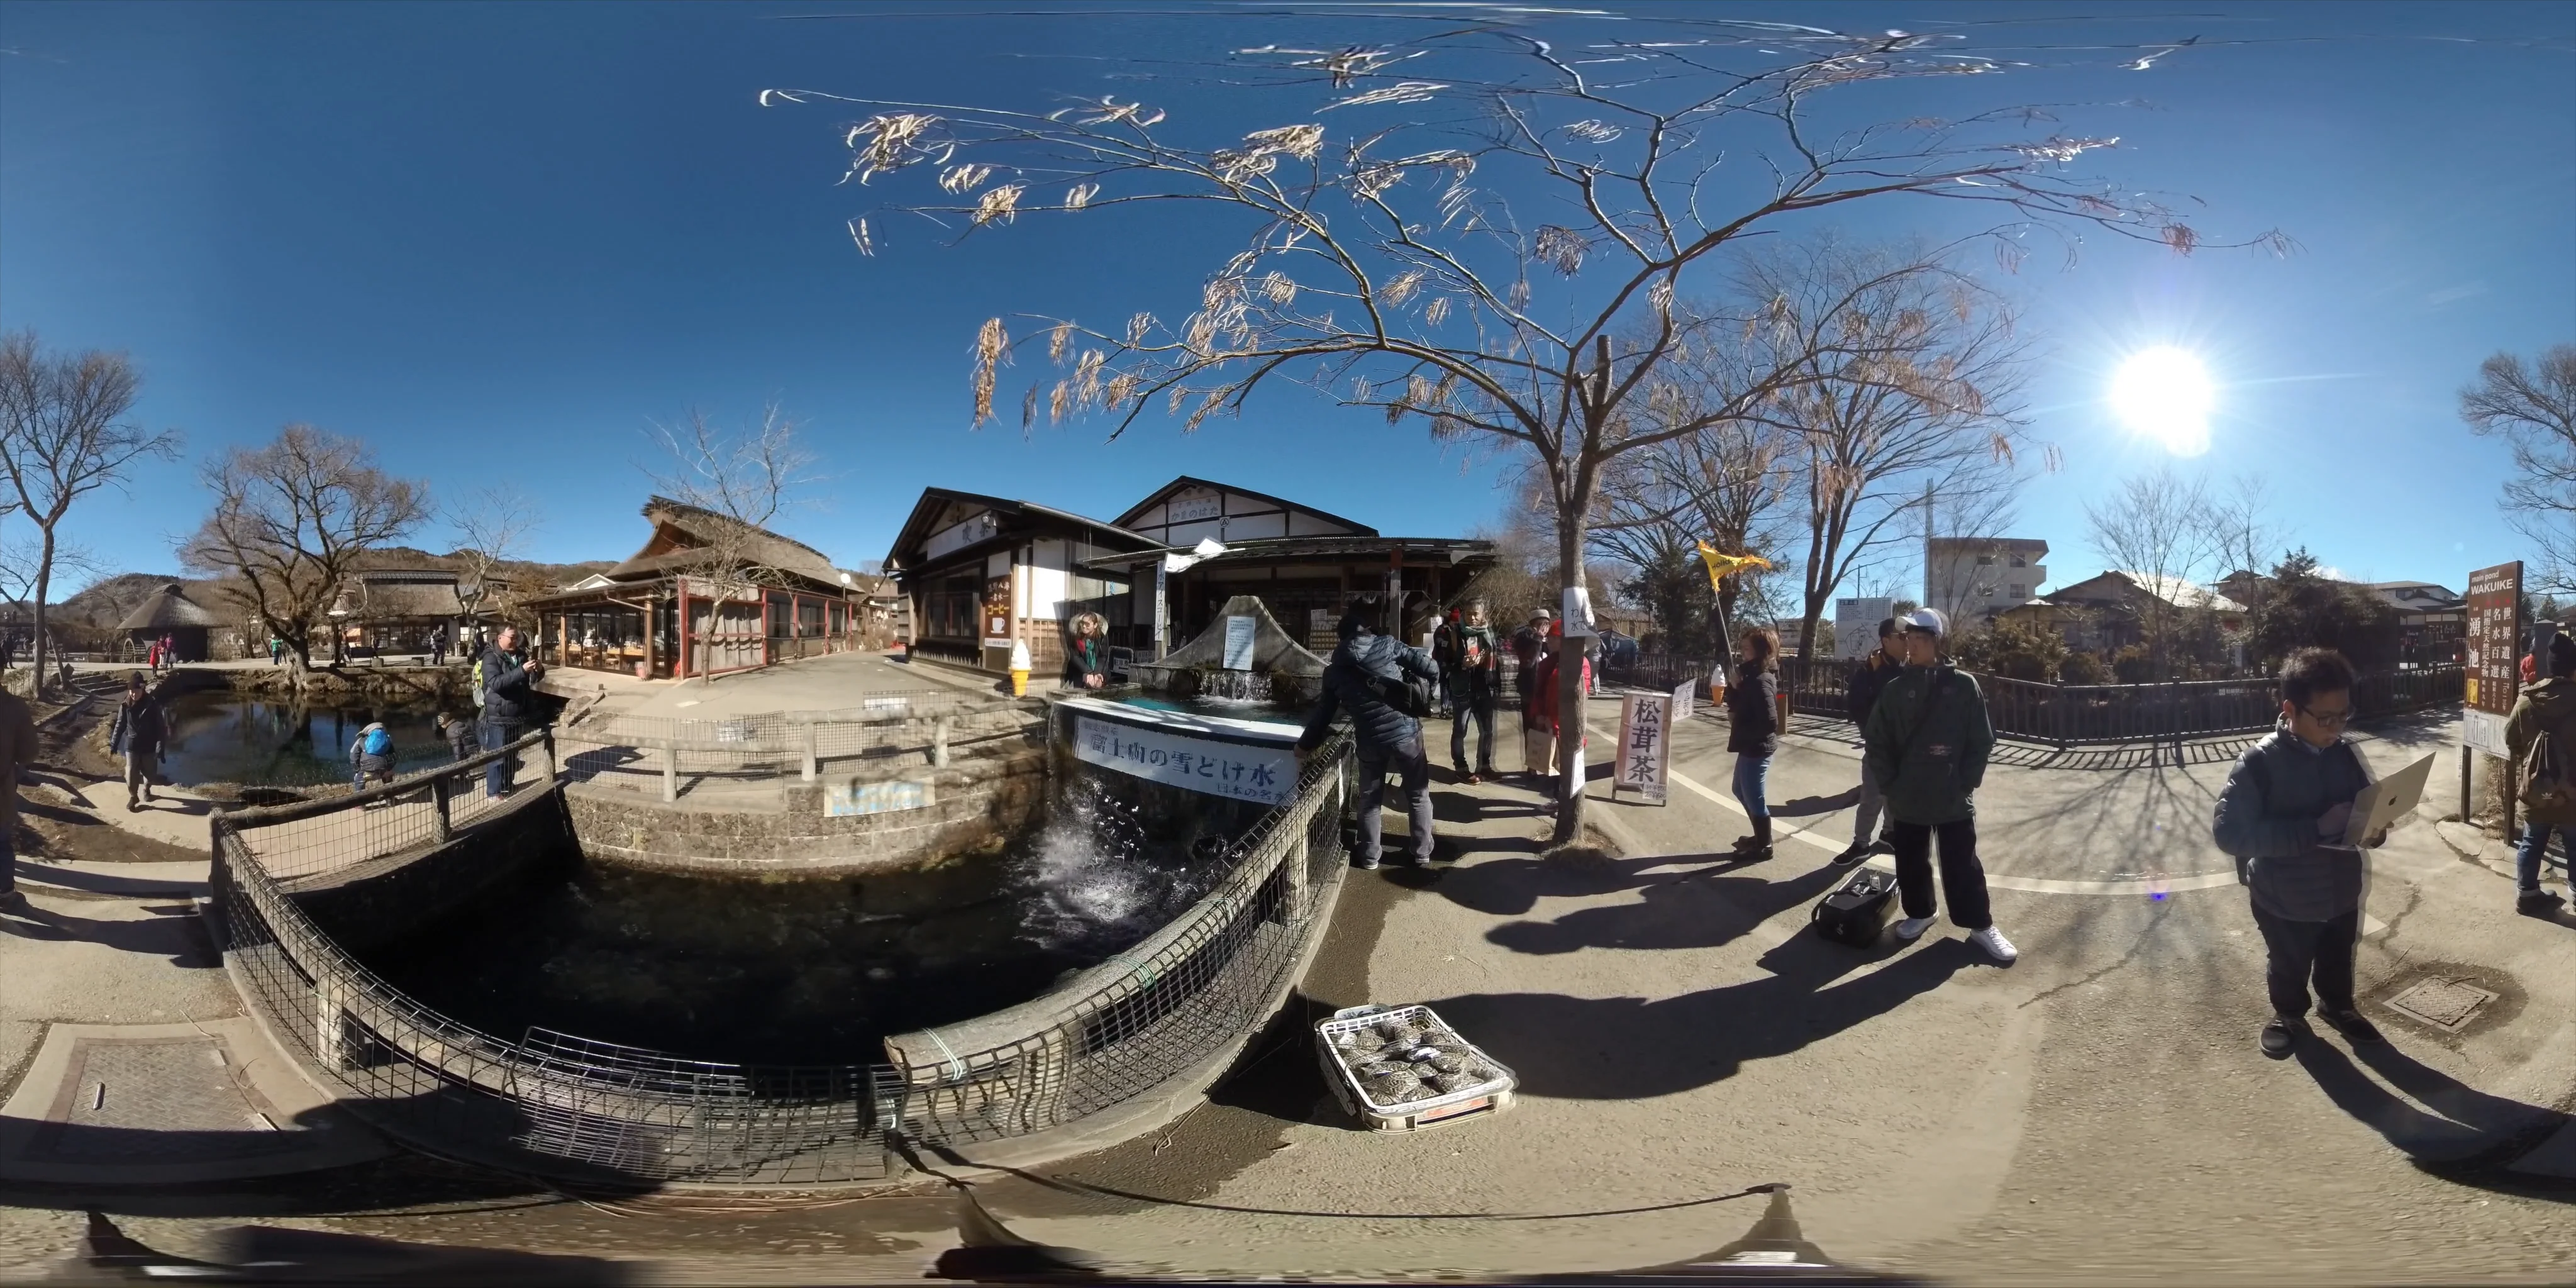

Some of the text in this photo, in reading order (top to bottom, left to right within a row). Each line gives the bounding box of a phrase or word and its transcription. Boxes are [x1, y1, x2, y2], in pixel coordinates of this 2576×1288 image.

[2471, 579, 2513, 595] WAKUIKE
[2472, 570, 2499, 583] main pond
[988, 603, 1009, 614] コーヒー
[2468, 617, 2481, 668] 湧池
[2481, 609, 2491, 677] 国指定天然記念物
[2490, 608, 2501, 678] 名水百選
[2501, 607, 2512, 679] 世界遺産
[1090, 733, 1276, 787] 富士山の雪どけ水
[1627, 698, 1662, 782] 松茸茶
